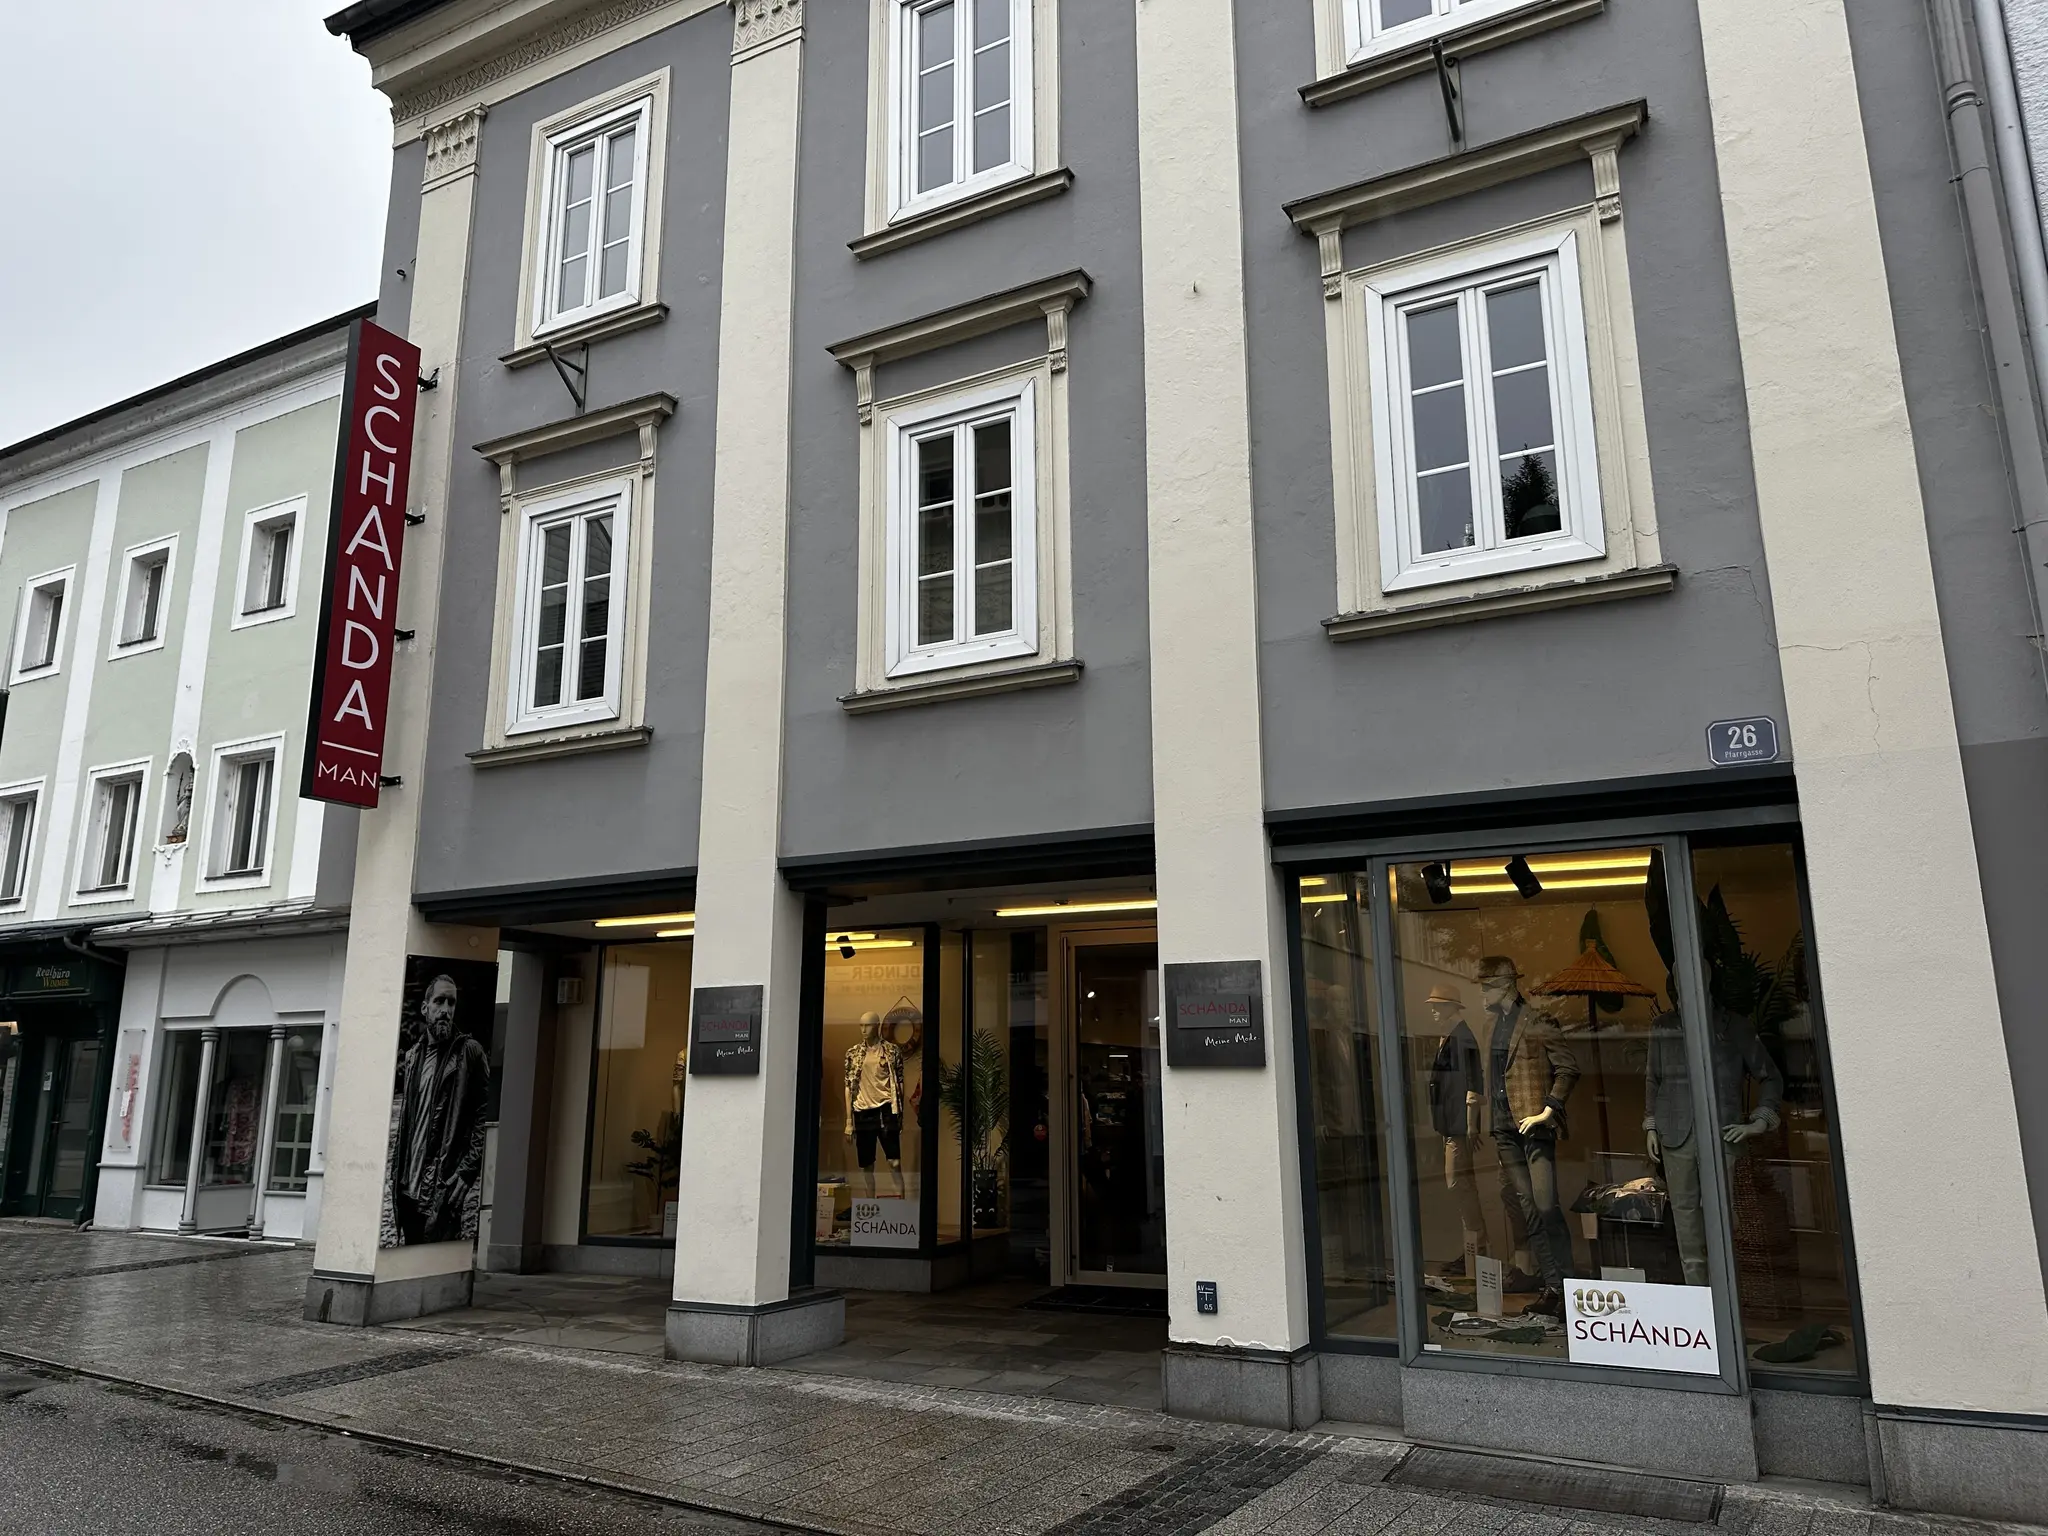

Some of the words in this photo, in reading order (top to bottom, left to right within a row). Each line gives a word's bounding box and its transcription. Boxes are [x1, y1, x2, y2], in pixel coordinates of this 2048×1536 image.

[333, 353, 401, 731] SCHANDA
[1727, 724, 1757, 749] 26
[1725, 749, 1764, 759] Pfarrgasse
[317, 760, 378, 789] MAN
[35, 965, 71, 979] Realbüro
[1179, 1001, 1247, 1015] SCHANDA
[701, 1019, 749, 1032] SCHANDA
[1204, 1036, 1231, 1047] Meine
[855, 1203, 881, 1219] 100
[853, 1220, 917, 1236] SCHANDA
[1573, 1288, 1627, 1314] 100
[1574, 1318, 1712, 1350] SCHANDA
